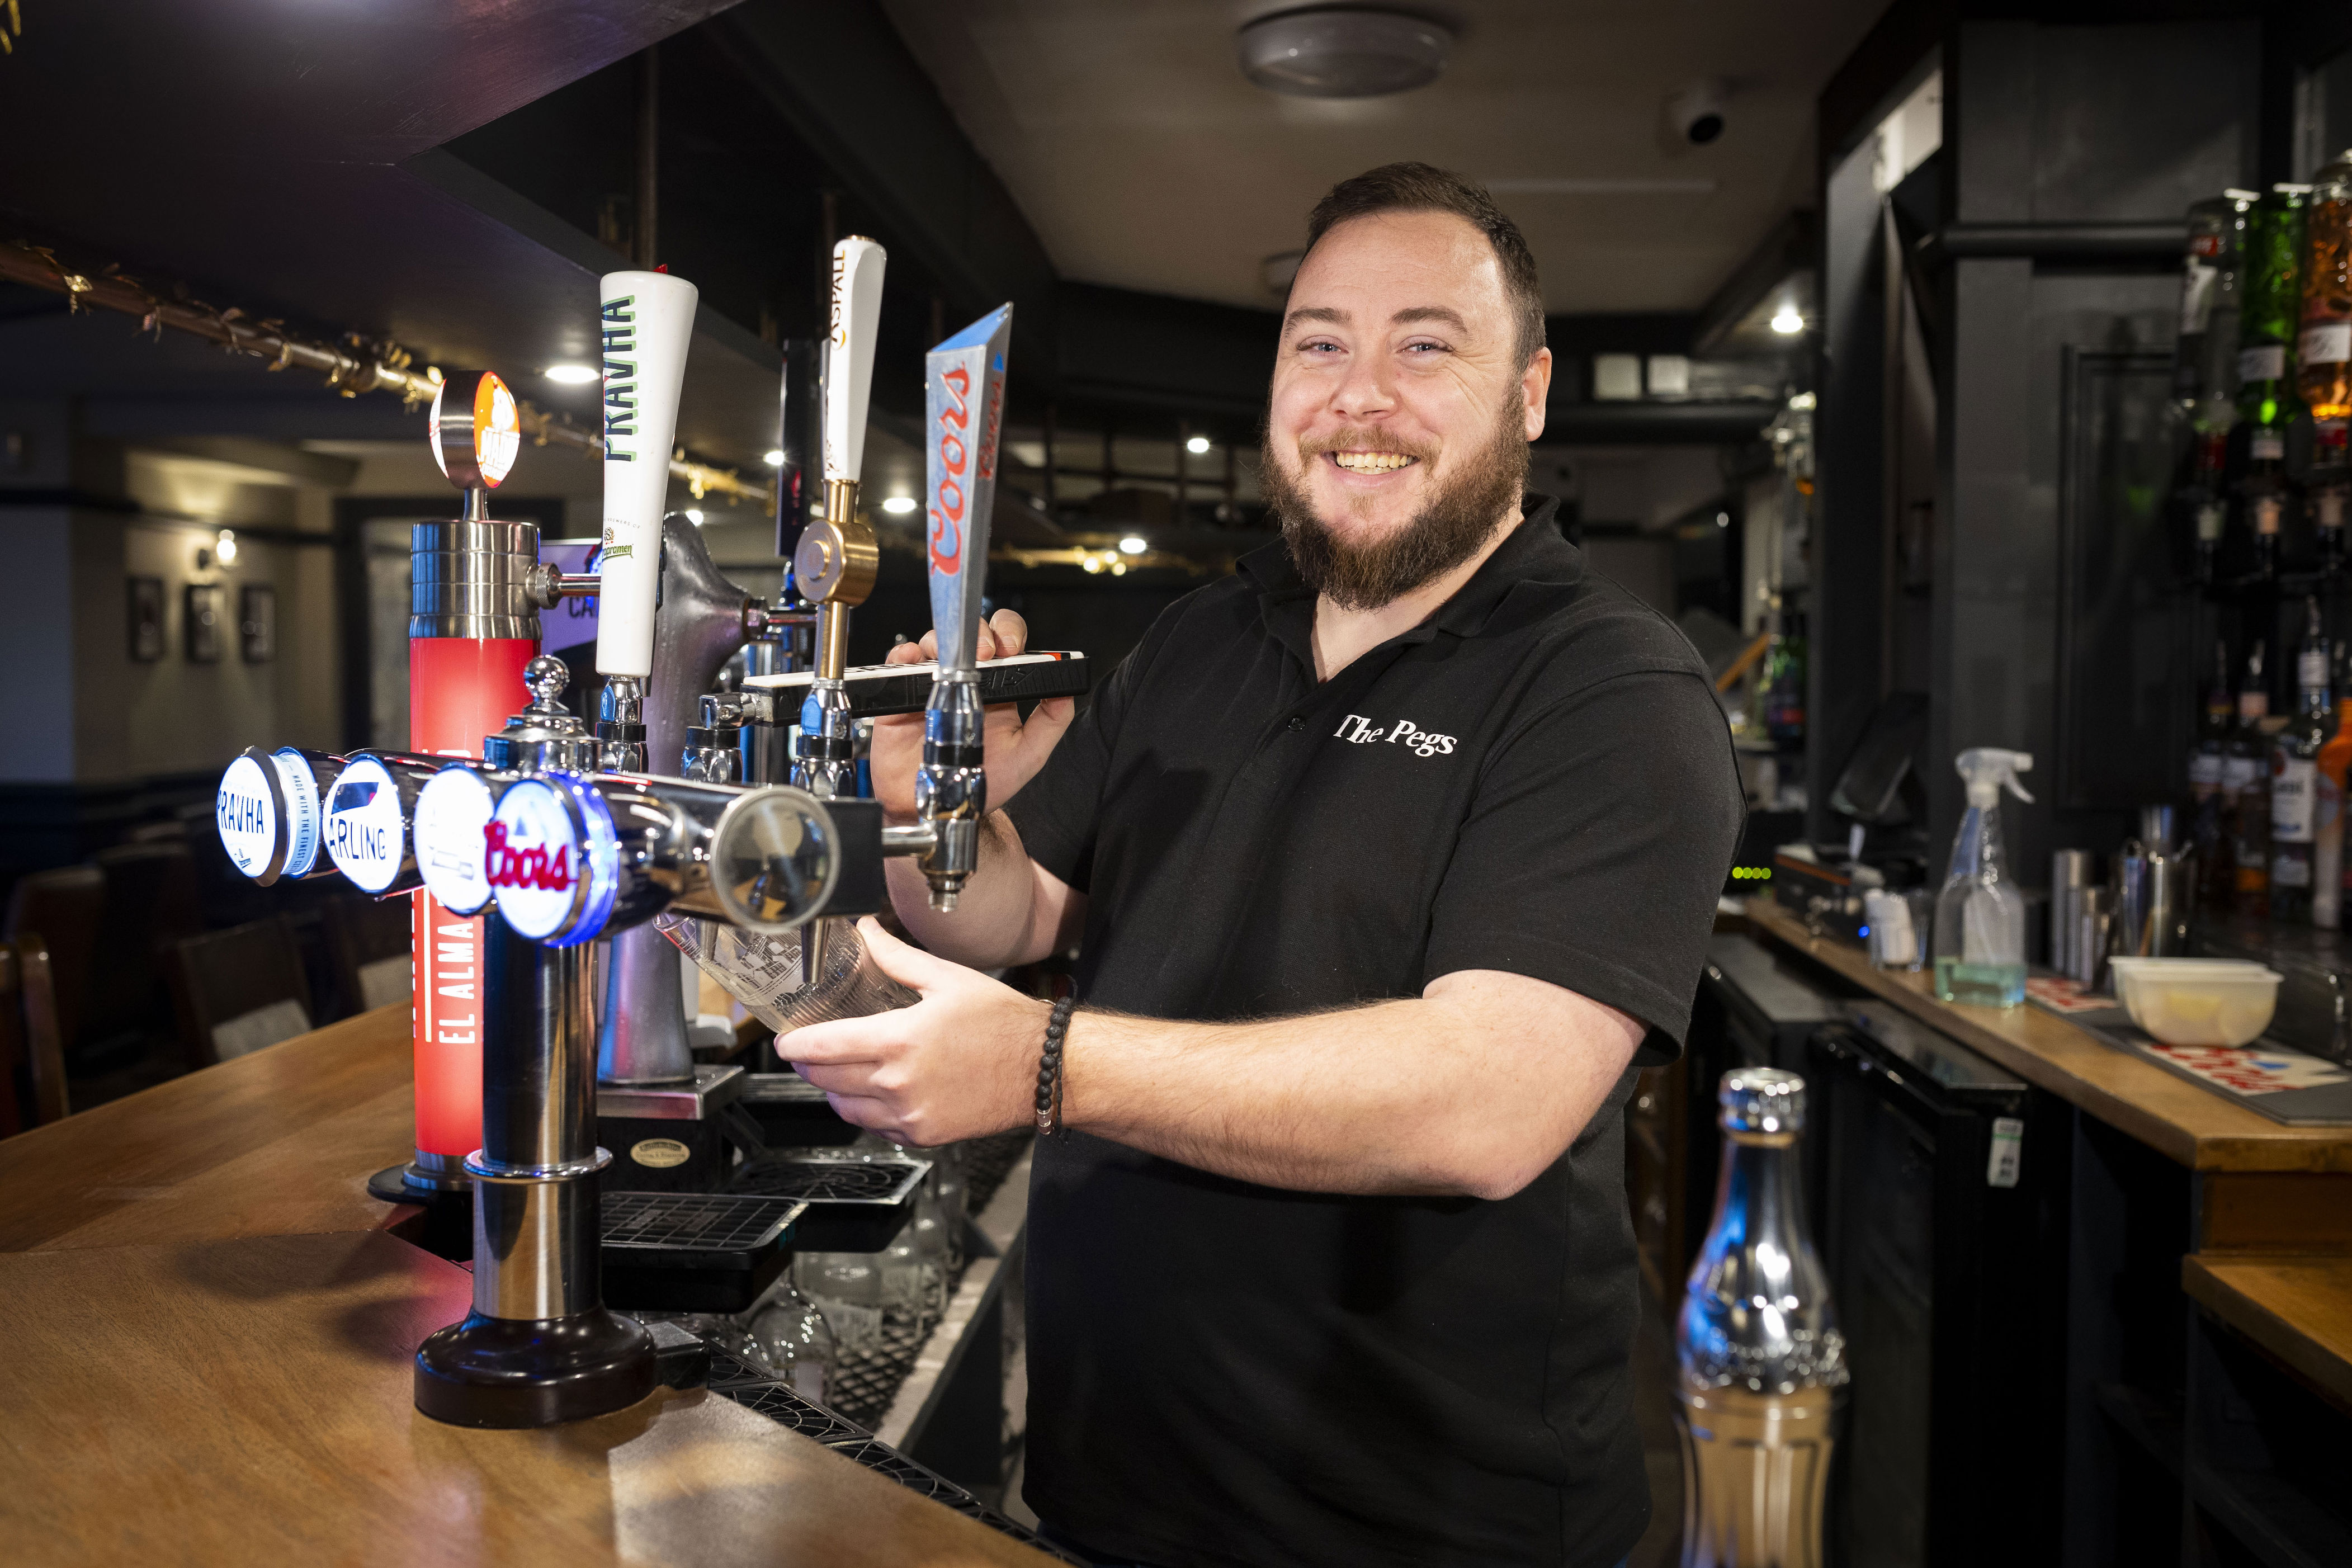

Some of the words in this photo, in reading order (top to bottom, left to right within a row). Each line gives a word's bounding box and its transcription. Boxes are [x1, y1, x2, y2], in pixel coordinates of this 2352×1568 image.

[602, 295, 637, 462] PRAVHA
[930, 361, 970, 577] Coors
[1333, 714, 1384, 744] The
[1385, 719, 1458, 757] Pegs
[292, 774, 305, 791] MADE
[217, 790, 264, 834] PRAVHA
[299, 795, 309, 814] WITH
[300, 818, 309, 833] THE
[296, 837, 309, 858] FINEST
[329, 818, 386, 860] ARLING
[484, 820, 578, 891] Coors
[437, 923, 475, 999] ALMA
[438, 1013, 475, 1044] EL
